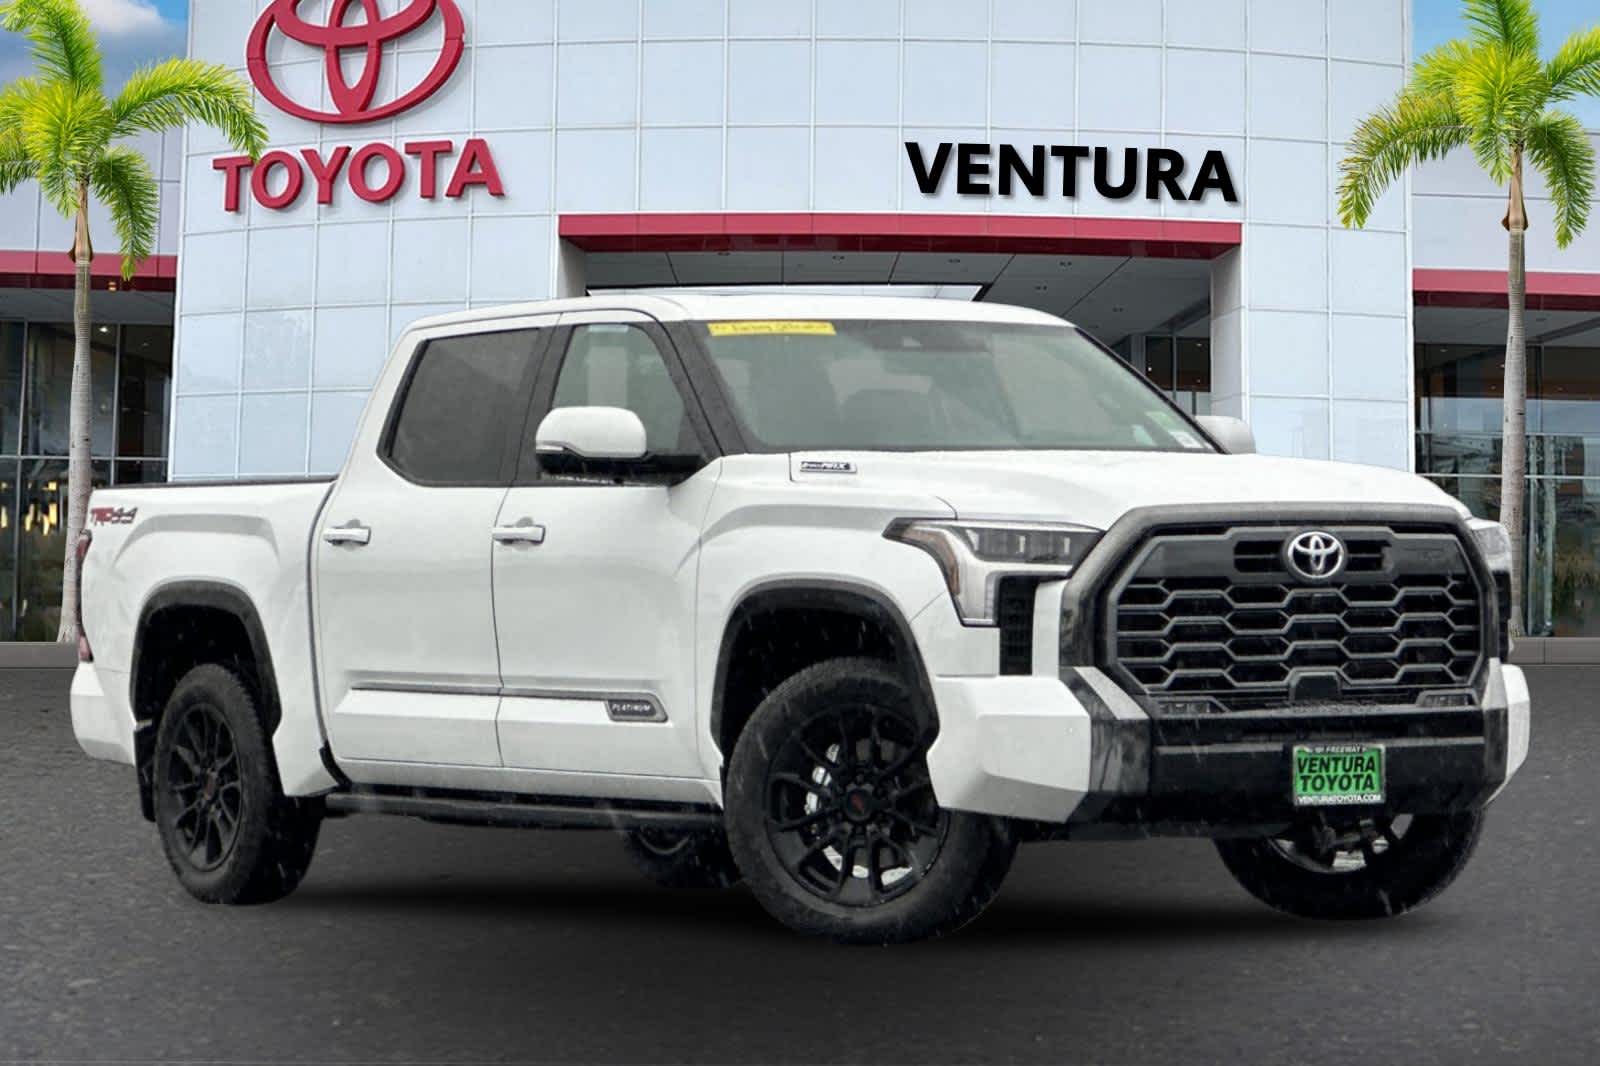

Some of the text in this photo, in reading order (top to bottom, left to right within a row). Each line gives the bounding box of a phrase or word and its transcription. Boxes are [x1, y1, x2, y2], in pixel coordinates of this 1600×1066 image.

[213, 139, 505, 212] TOYOTA
[904, 141, 1238, 203] VENTURA
[1297, 755, 1376, 773] VENTURA
[1300, 773, 1375, 792] TOYOTA
